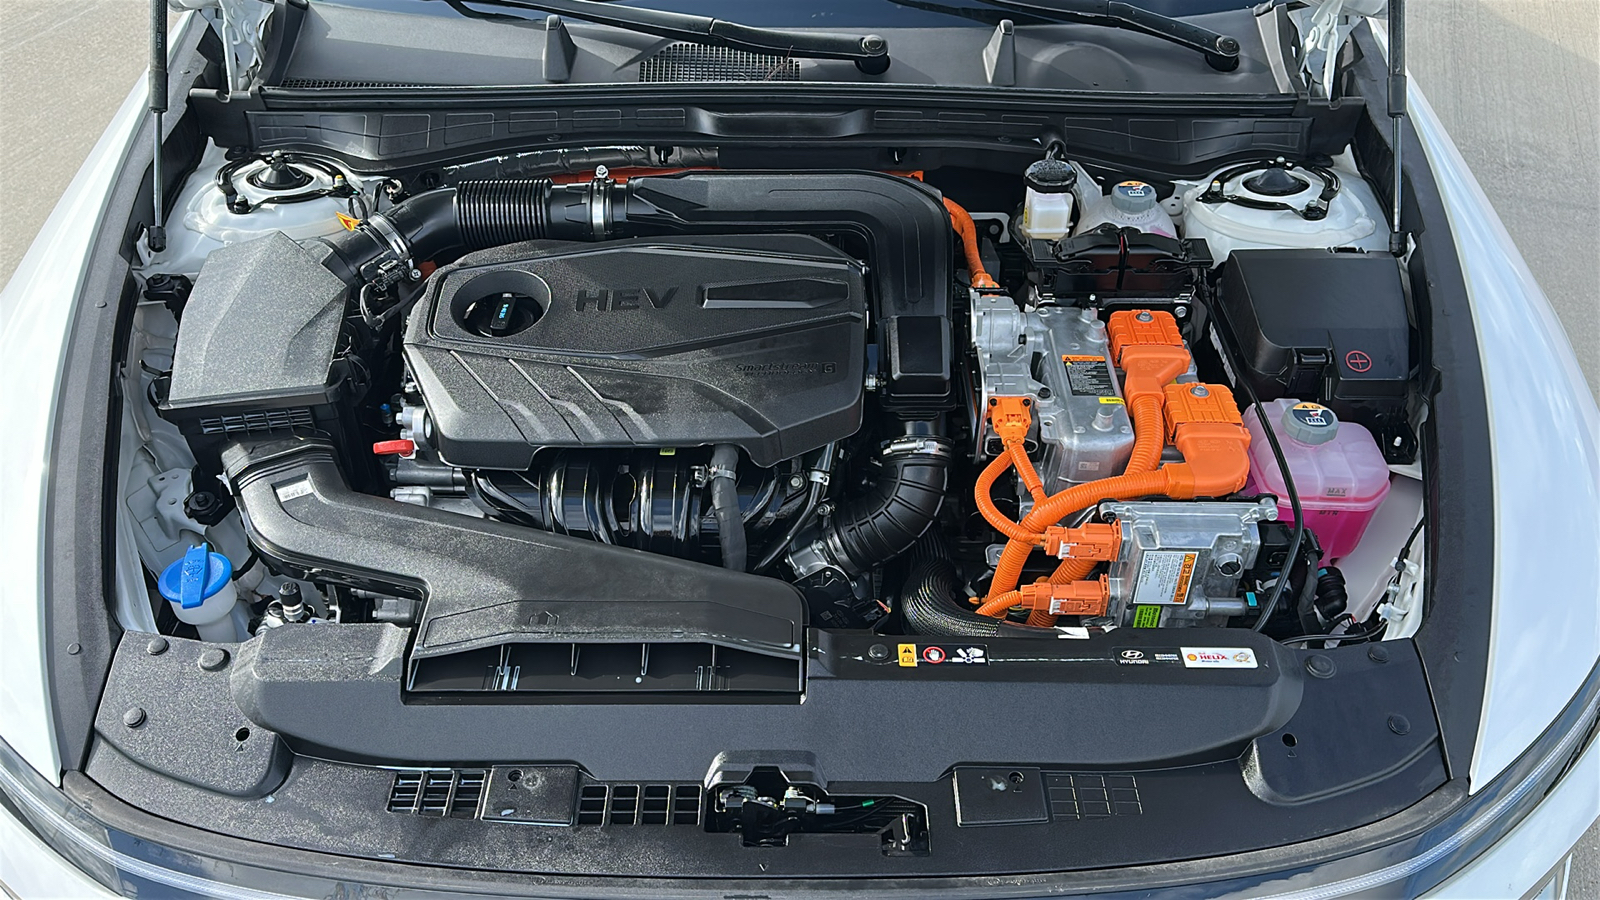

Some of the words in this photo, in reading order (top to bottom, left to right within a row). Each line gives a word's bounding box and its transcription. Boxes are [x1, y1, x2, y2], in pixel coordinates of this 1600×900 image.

[575, 286, 679, 312] HEV
[735, 361, 819, 372] Smartstream
[1327, 487, 1348, 495] MAX
